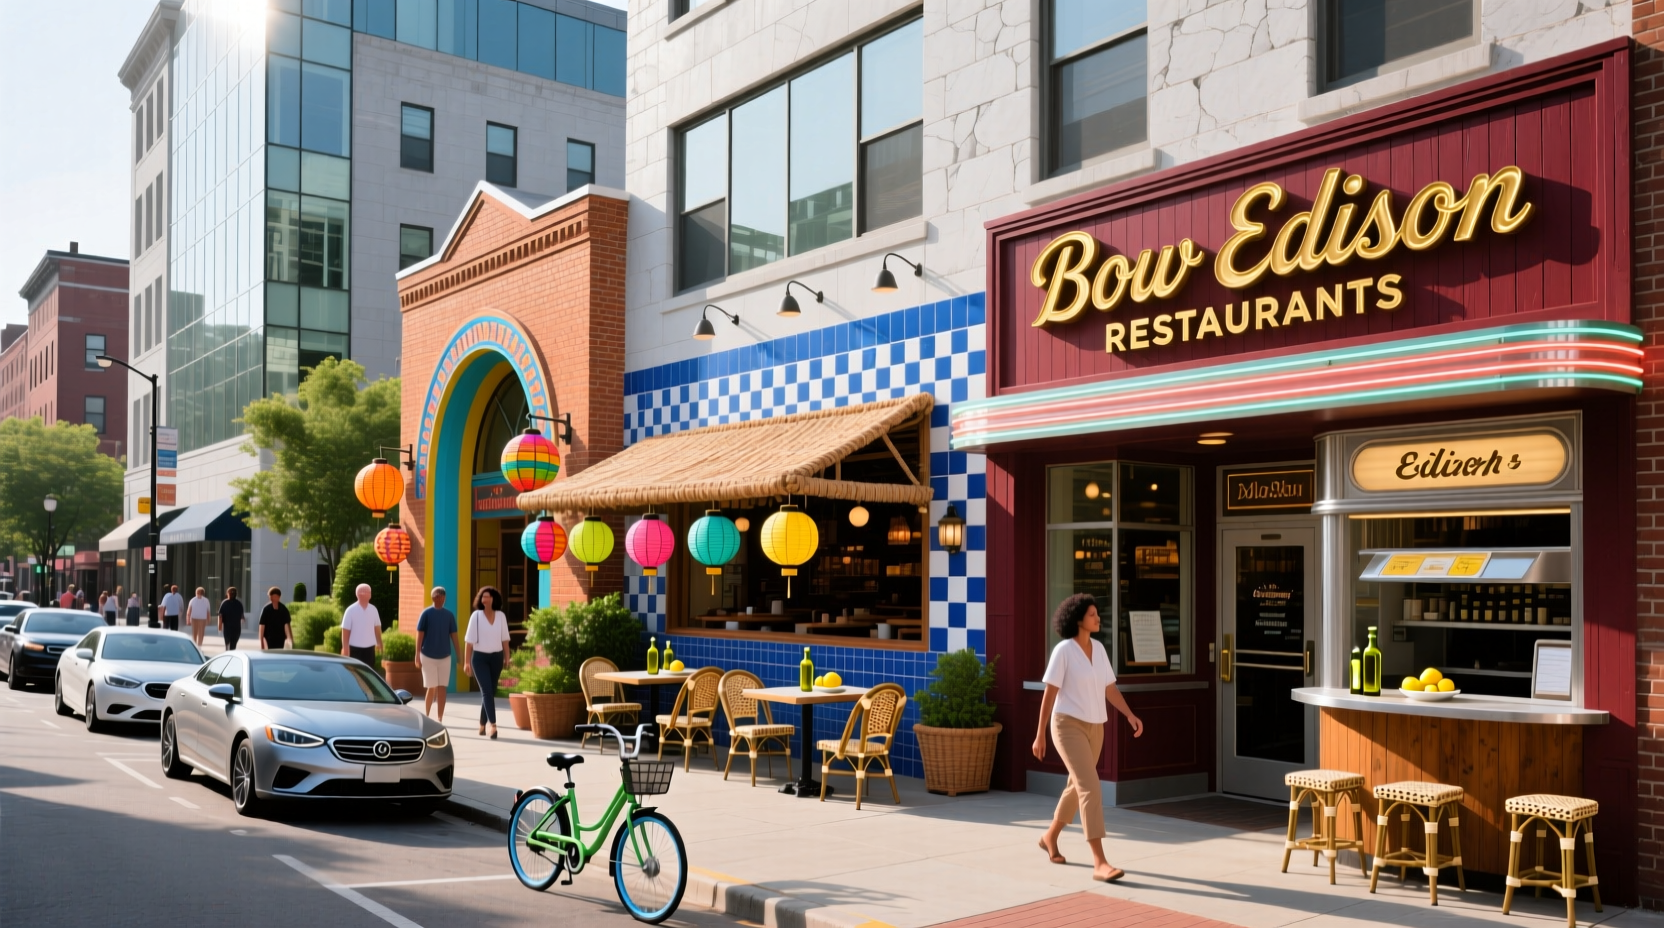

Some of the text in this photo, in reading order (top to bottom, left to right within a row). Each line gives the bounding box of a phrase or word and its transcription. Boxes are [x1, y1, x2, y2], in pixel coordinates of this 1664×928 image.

[1030, 165, 1534, 328] Bow Edison
[1105, 273, 1403, 354] RESTAURANTS
